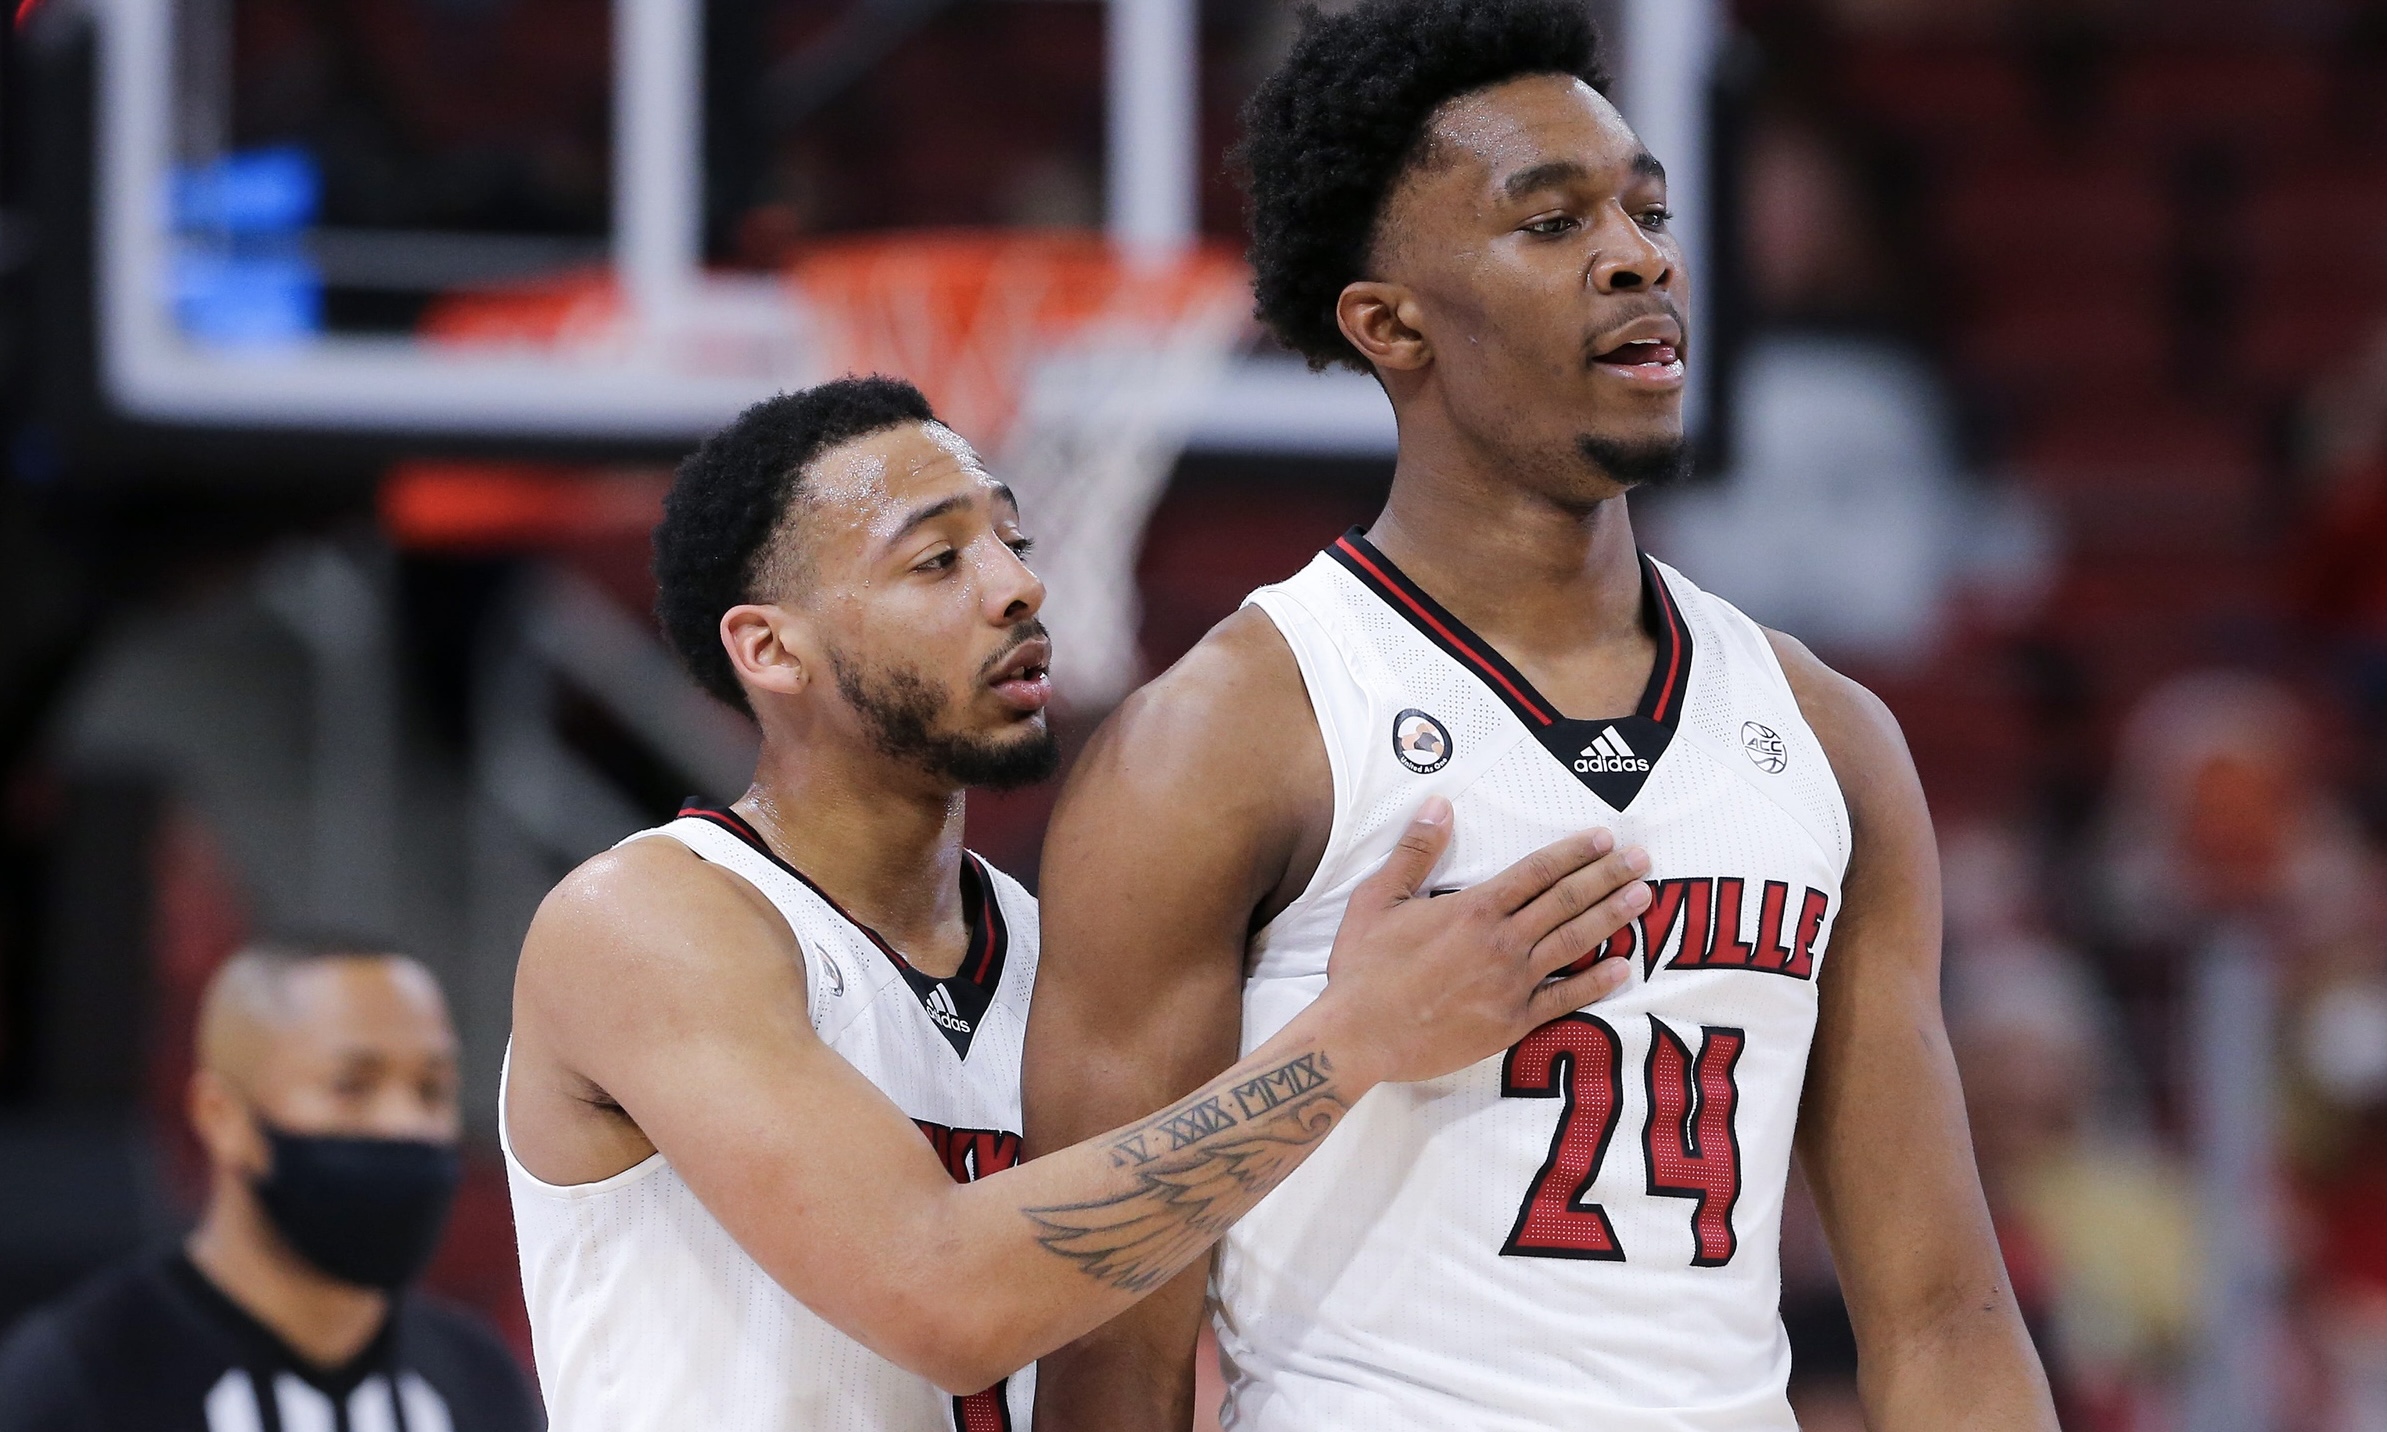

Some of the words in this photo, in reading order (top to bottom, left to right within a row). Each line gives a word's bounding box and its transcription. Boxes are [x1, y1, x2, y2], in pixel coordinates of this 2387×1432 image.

[1747, 737, 1782, 752] ACC
[1401, 756, 1423, 773] United
[1434, 757, 1448, 770] One
[1573, 754, 1650, 773] adidas
[1498, 1011, 1746, 1268] 24
